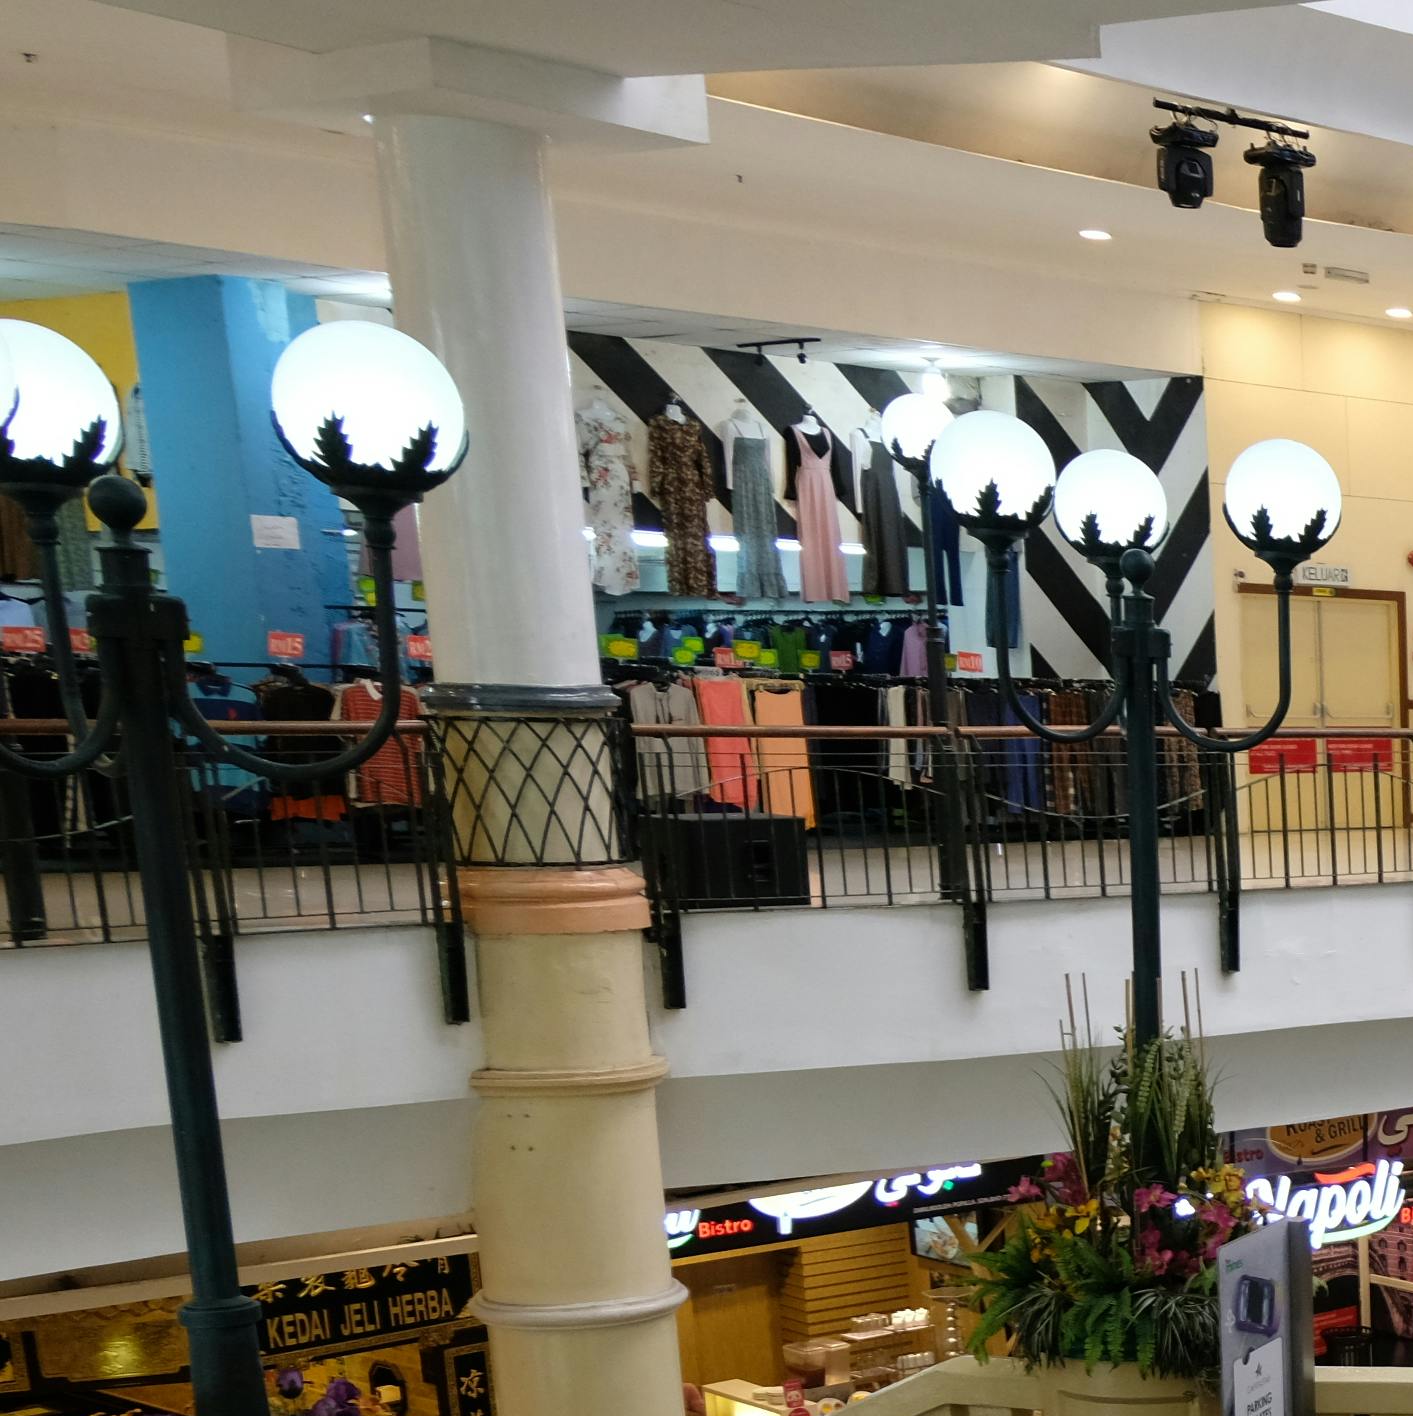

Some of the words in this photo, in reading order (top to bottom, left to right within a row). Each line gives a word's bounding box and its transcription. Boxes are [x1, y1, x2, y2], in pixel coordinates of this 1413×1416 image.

[1301, 566, 1342, 582] KELUAR
[1328, 1117, 1365, 1140] GRILL
[697, 1217, 754, 1238] Bistro
[266, 1308, 331, 1349] KEDAI
[340, 1300, 382, 1337] JELI
[388, 1287, 454, 1327] HERBA
[1246, 1391, 1273, 1416] PARKING
